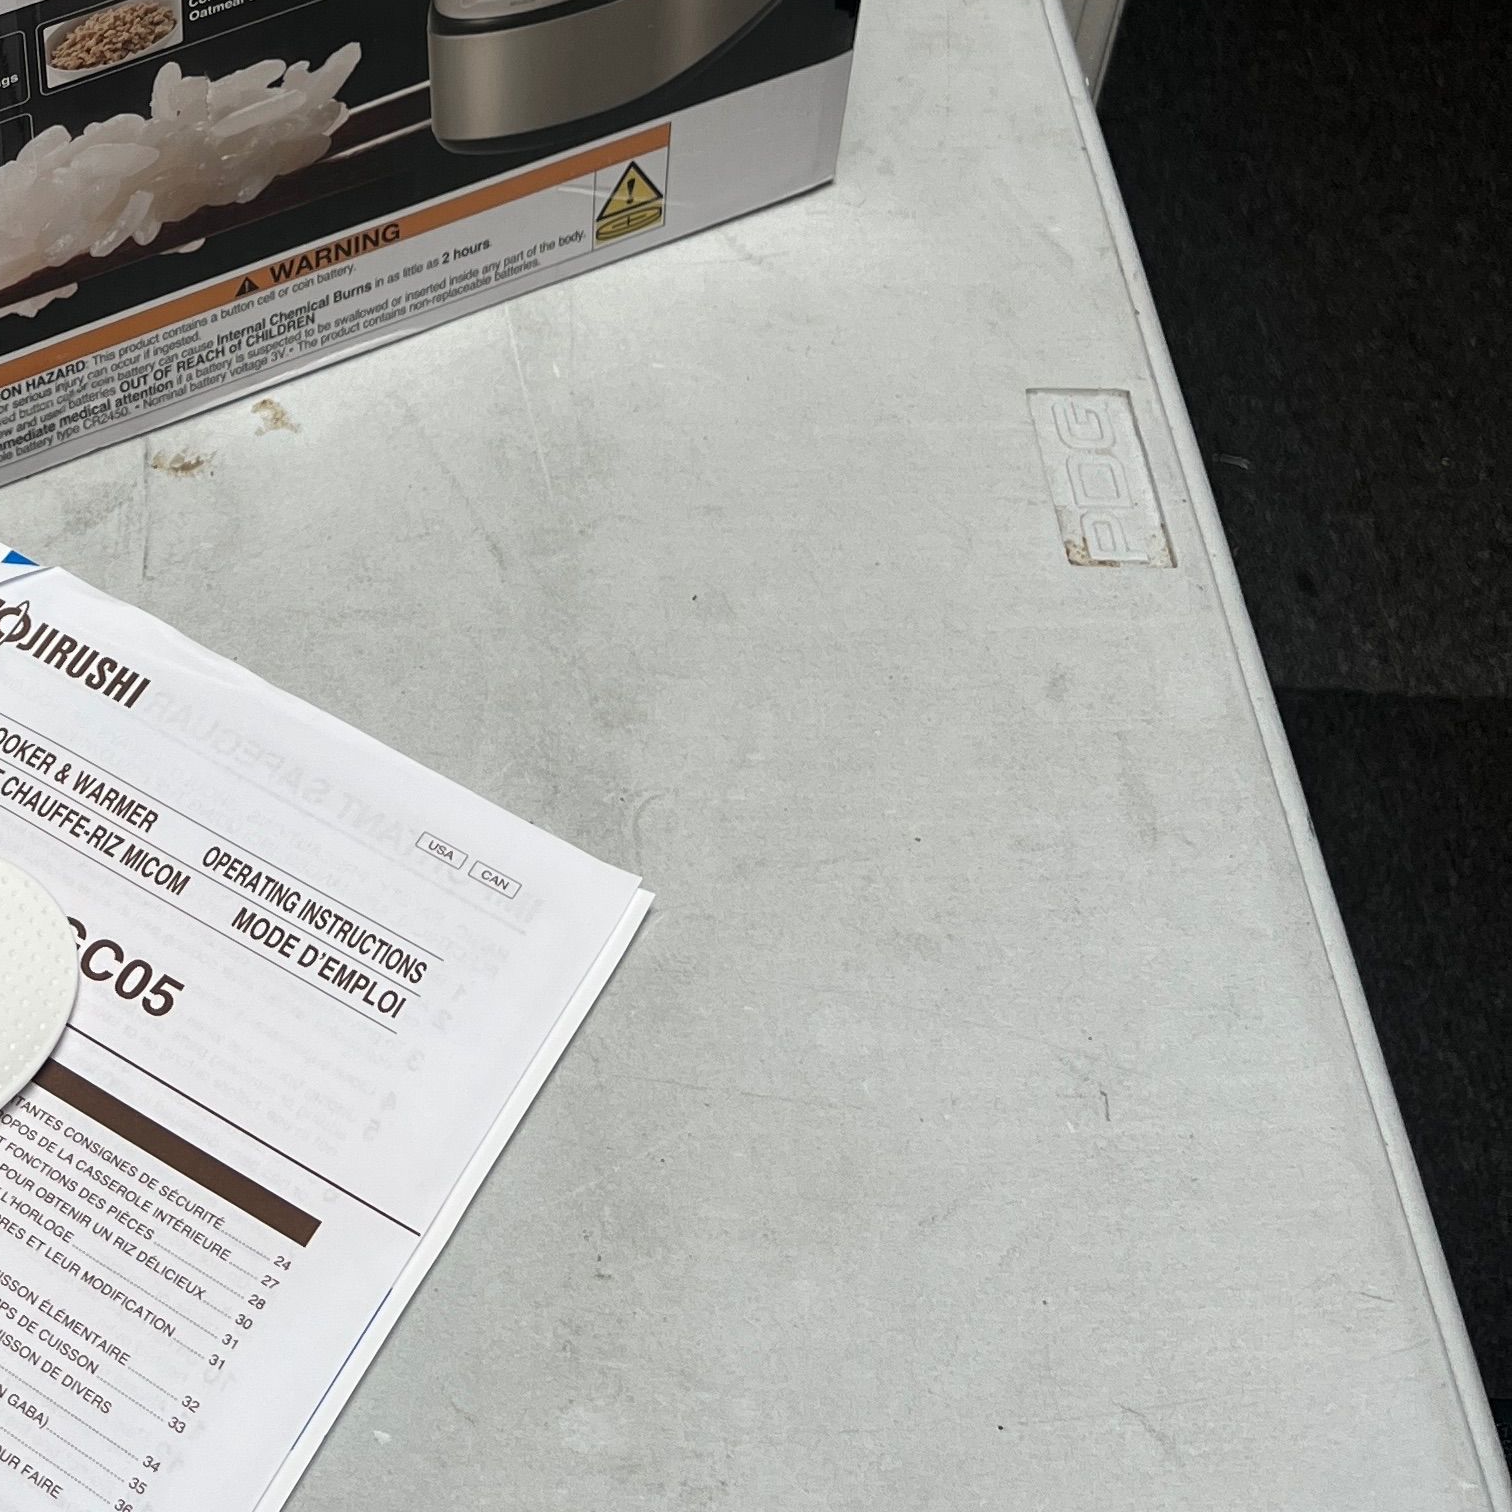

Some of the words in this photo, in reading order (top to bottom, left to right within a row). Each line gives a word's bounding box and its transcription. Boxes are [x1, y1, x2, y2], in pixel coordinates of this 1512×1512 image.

[269, 221, 402, 287] WARNING
[25, 360, 88, 392] HAZARD:
[92, 351, 116, 366] This
[118, 334, 160, 359] product
[162, 317, 208, 341] contains
[210, 313, 219, 324] a
[220, 300, 255, 320] button
[256, 290, 276, 306] cell
[277, 286, 290, 299] or
[291, 278, 315, 294] coin
[316, 264, 357, 285] battery.
[119, 372, 150, 393] OUT
[151, 364, 172, 382] OF
[176, 345, 225, 374] REACH
[228, 338, 242, 355] of
[246, 312, 316, 348] CHILDREN
[0, 776, 125, 857] CHAUFFE-RIZ
[119, 844, 191, 896] MICOM
[53, 762, 72, 785] &
[72, 770, 159, 833] WARMER
[428, 839, 454, 861] USA
[480, 870, 510, 891] CAN
[202, 846, 301, 913] OPERATING
[297, 899, 427, 984] INSTRUCTIONS
[231, 907, 301, 958] MODE
[297, 944, 406, 1018] D'EMPLOI
[63, 1126, 139, 1177] CONSIGNES
[137, 1171, 160, 1191] DE
[158, 1185, 225, 1231] SÉCURITÉ
[273, 1255, 292, 1271] 24
